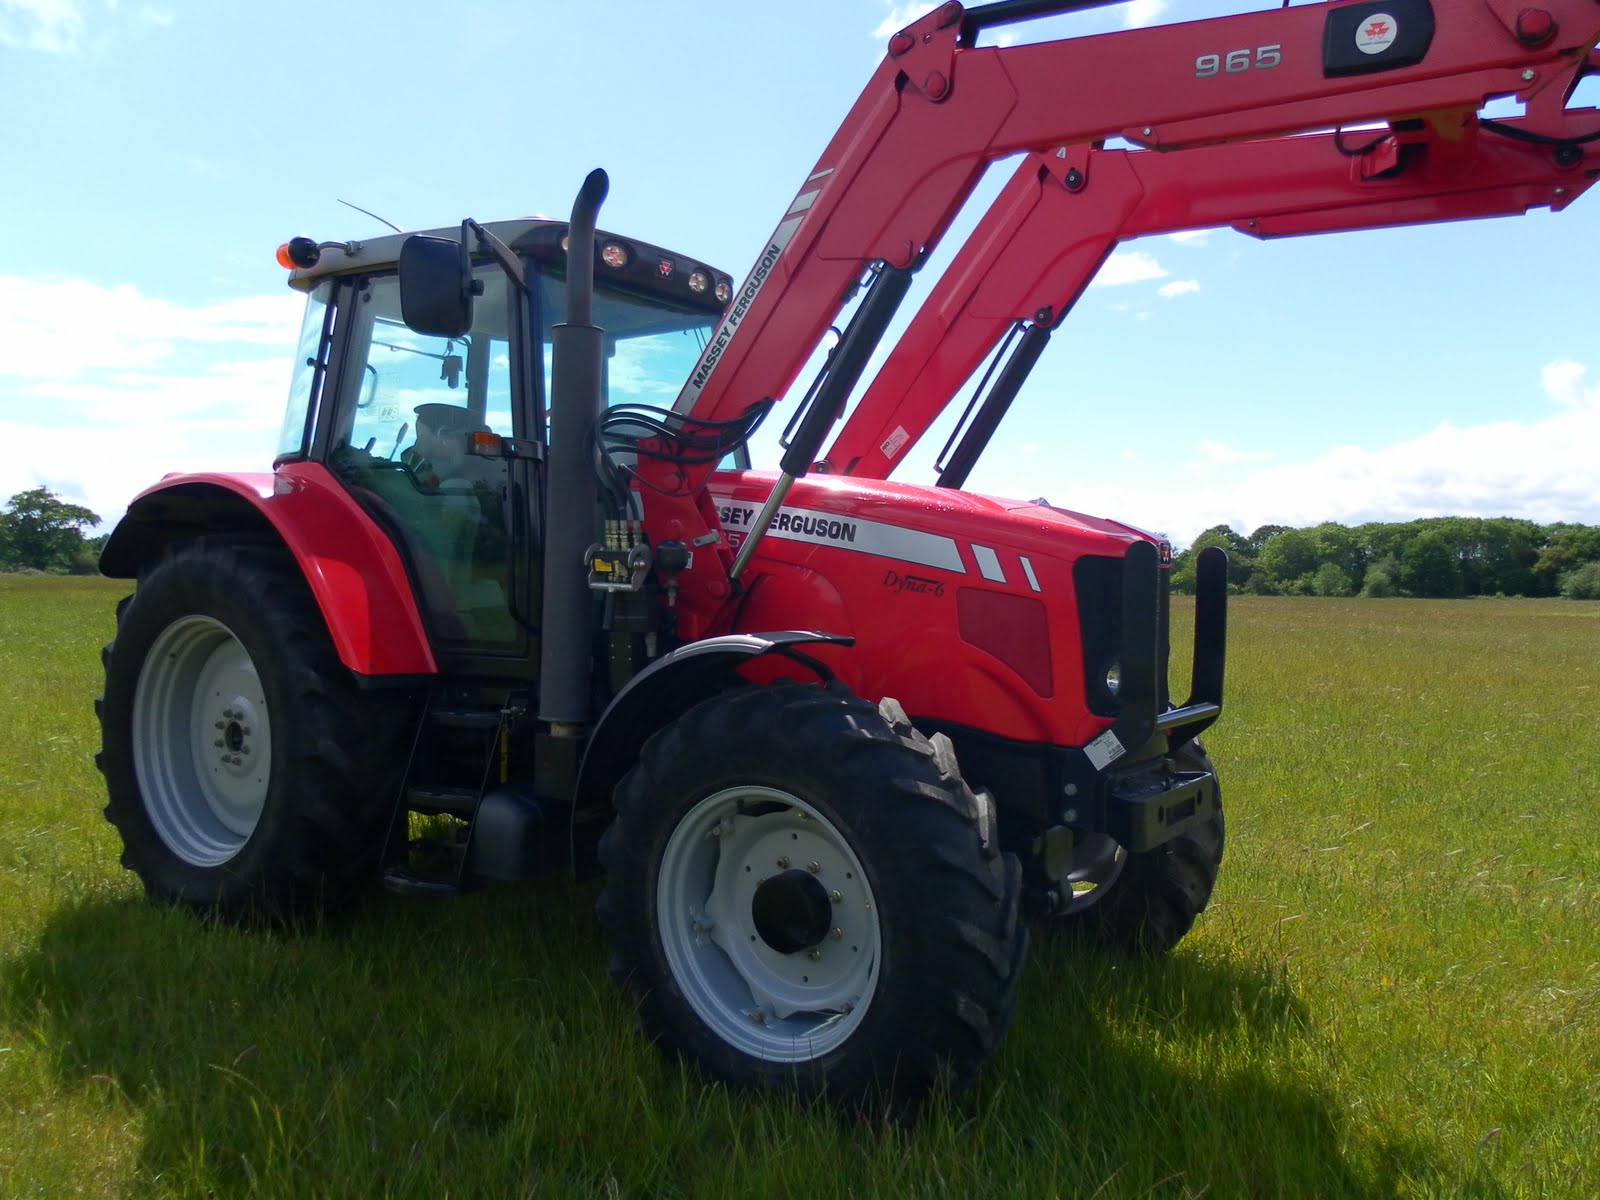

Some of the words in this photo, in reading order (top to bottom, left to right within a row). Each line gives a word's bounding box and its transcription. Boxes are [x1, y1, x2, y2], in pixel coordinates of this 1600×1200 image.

[1195, 44, 1281, 78] 965
[693, 326, 731, 389] MASSEY
[728, 244, 781, 326] FERGUSON
[715, 505, 754, 526] SEY
[769, 512, 857, 542] ERGUSON
[883, 570, 945, 598] Dyna-6
